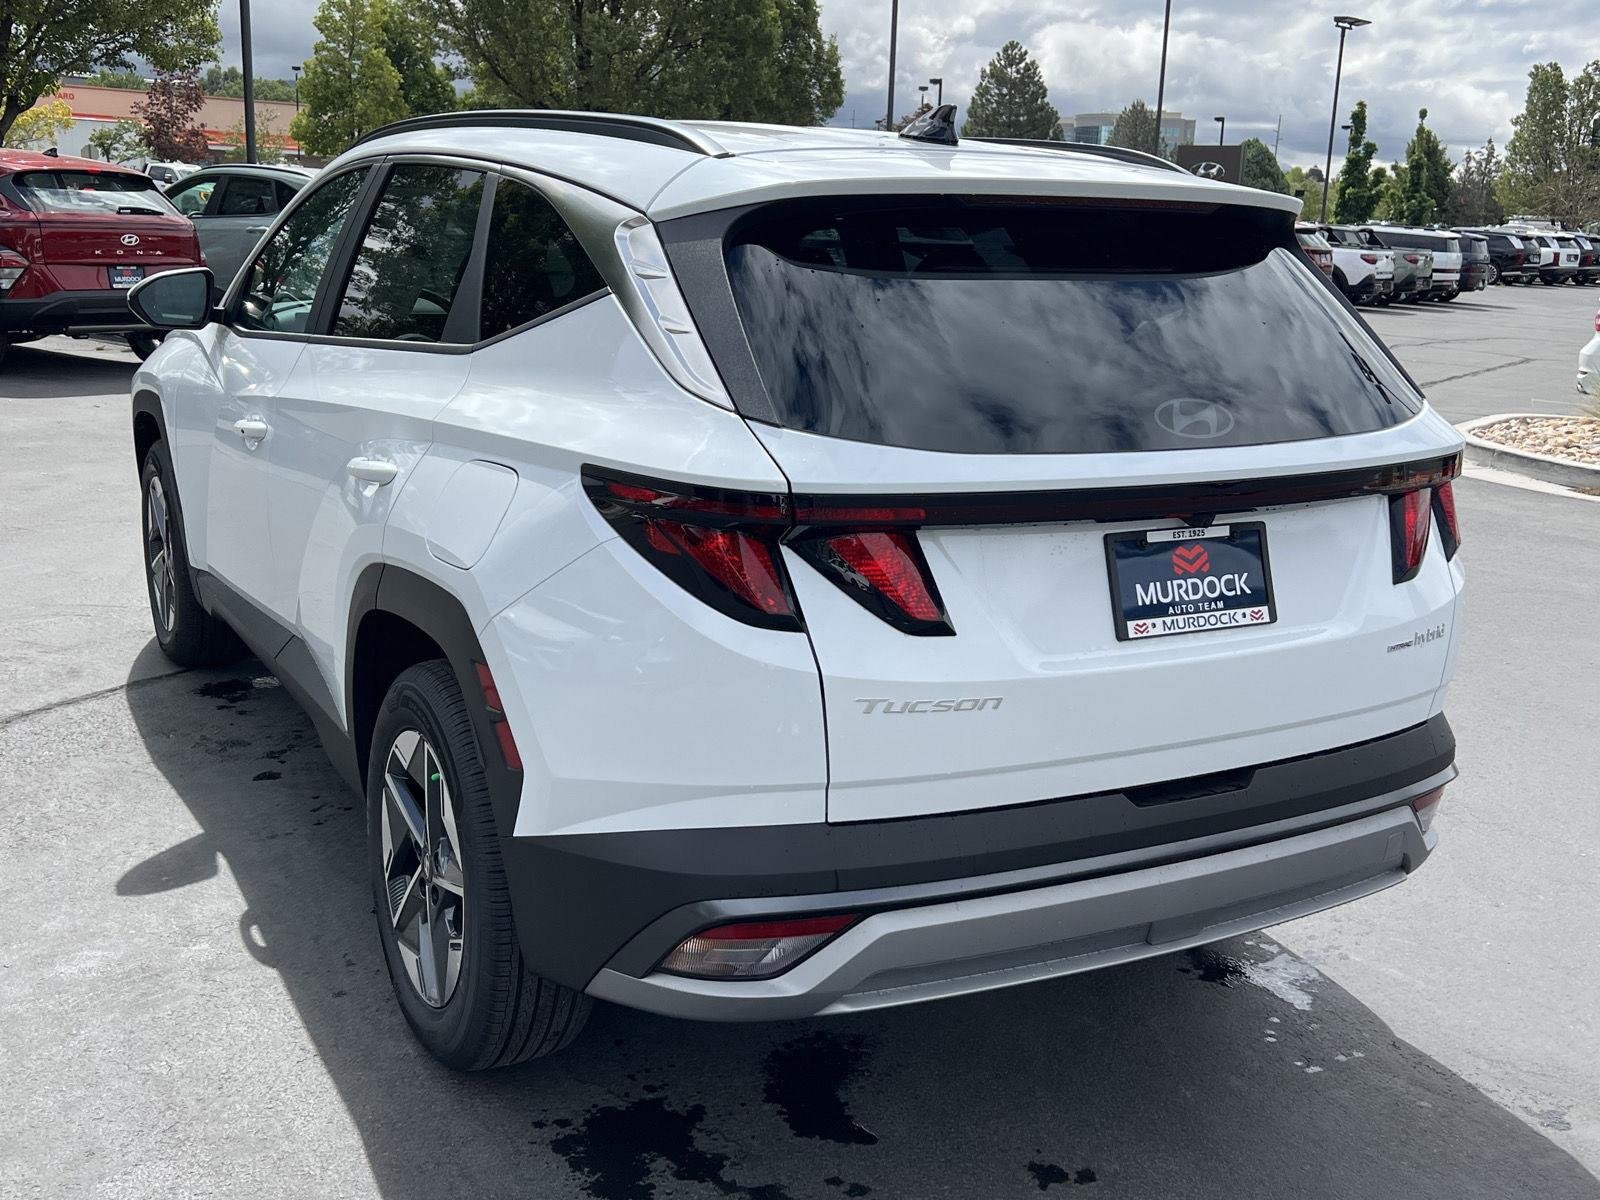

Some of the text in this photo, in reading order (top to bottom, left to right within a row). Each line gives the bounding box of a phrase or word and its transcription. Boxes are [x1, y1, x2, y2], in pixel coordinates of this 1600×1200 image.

[1172, 529, 1206, 539] EST. 1925
[1135, 573, 1252, 606] MURDOCK
[1168, 600, 1224, 615] AUTO TEAM
[1162, 611, 1240, 632] MURDOCK
